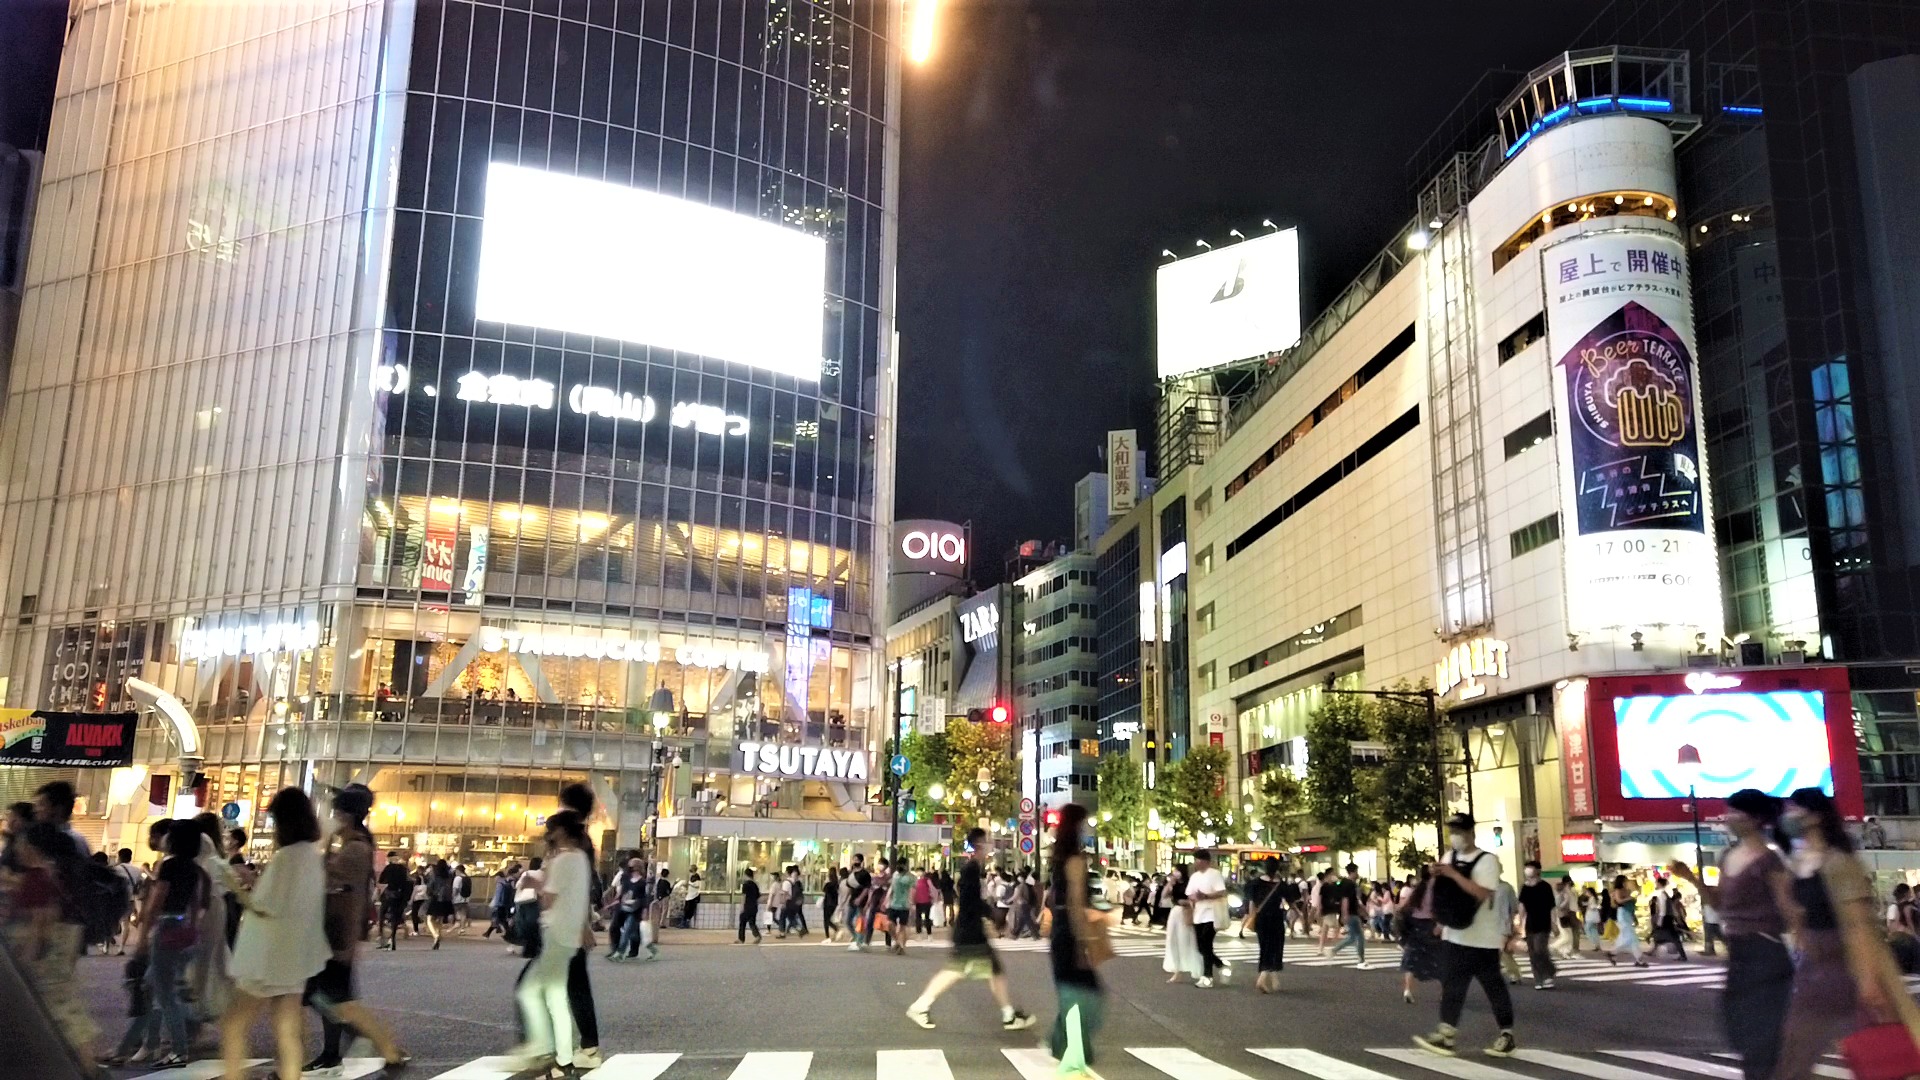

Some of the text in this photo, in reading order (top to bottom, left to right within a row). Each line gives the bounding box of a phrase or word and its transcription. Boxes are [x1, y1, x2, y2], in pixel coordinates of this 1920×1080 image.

[1560, 249, 1682, 285] 屋上で開催中
[1580, 339, 1685, 382] Beer TERRACE
[1584, 381, 1609, 429] SHIBUYA
[1114, 436, 1130, 496] 大和証券
[960, 603, 999, 643] ZARA
[739, 742, 867, 780] TSUTAYA
